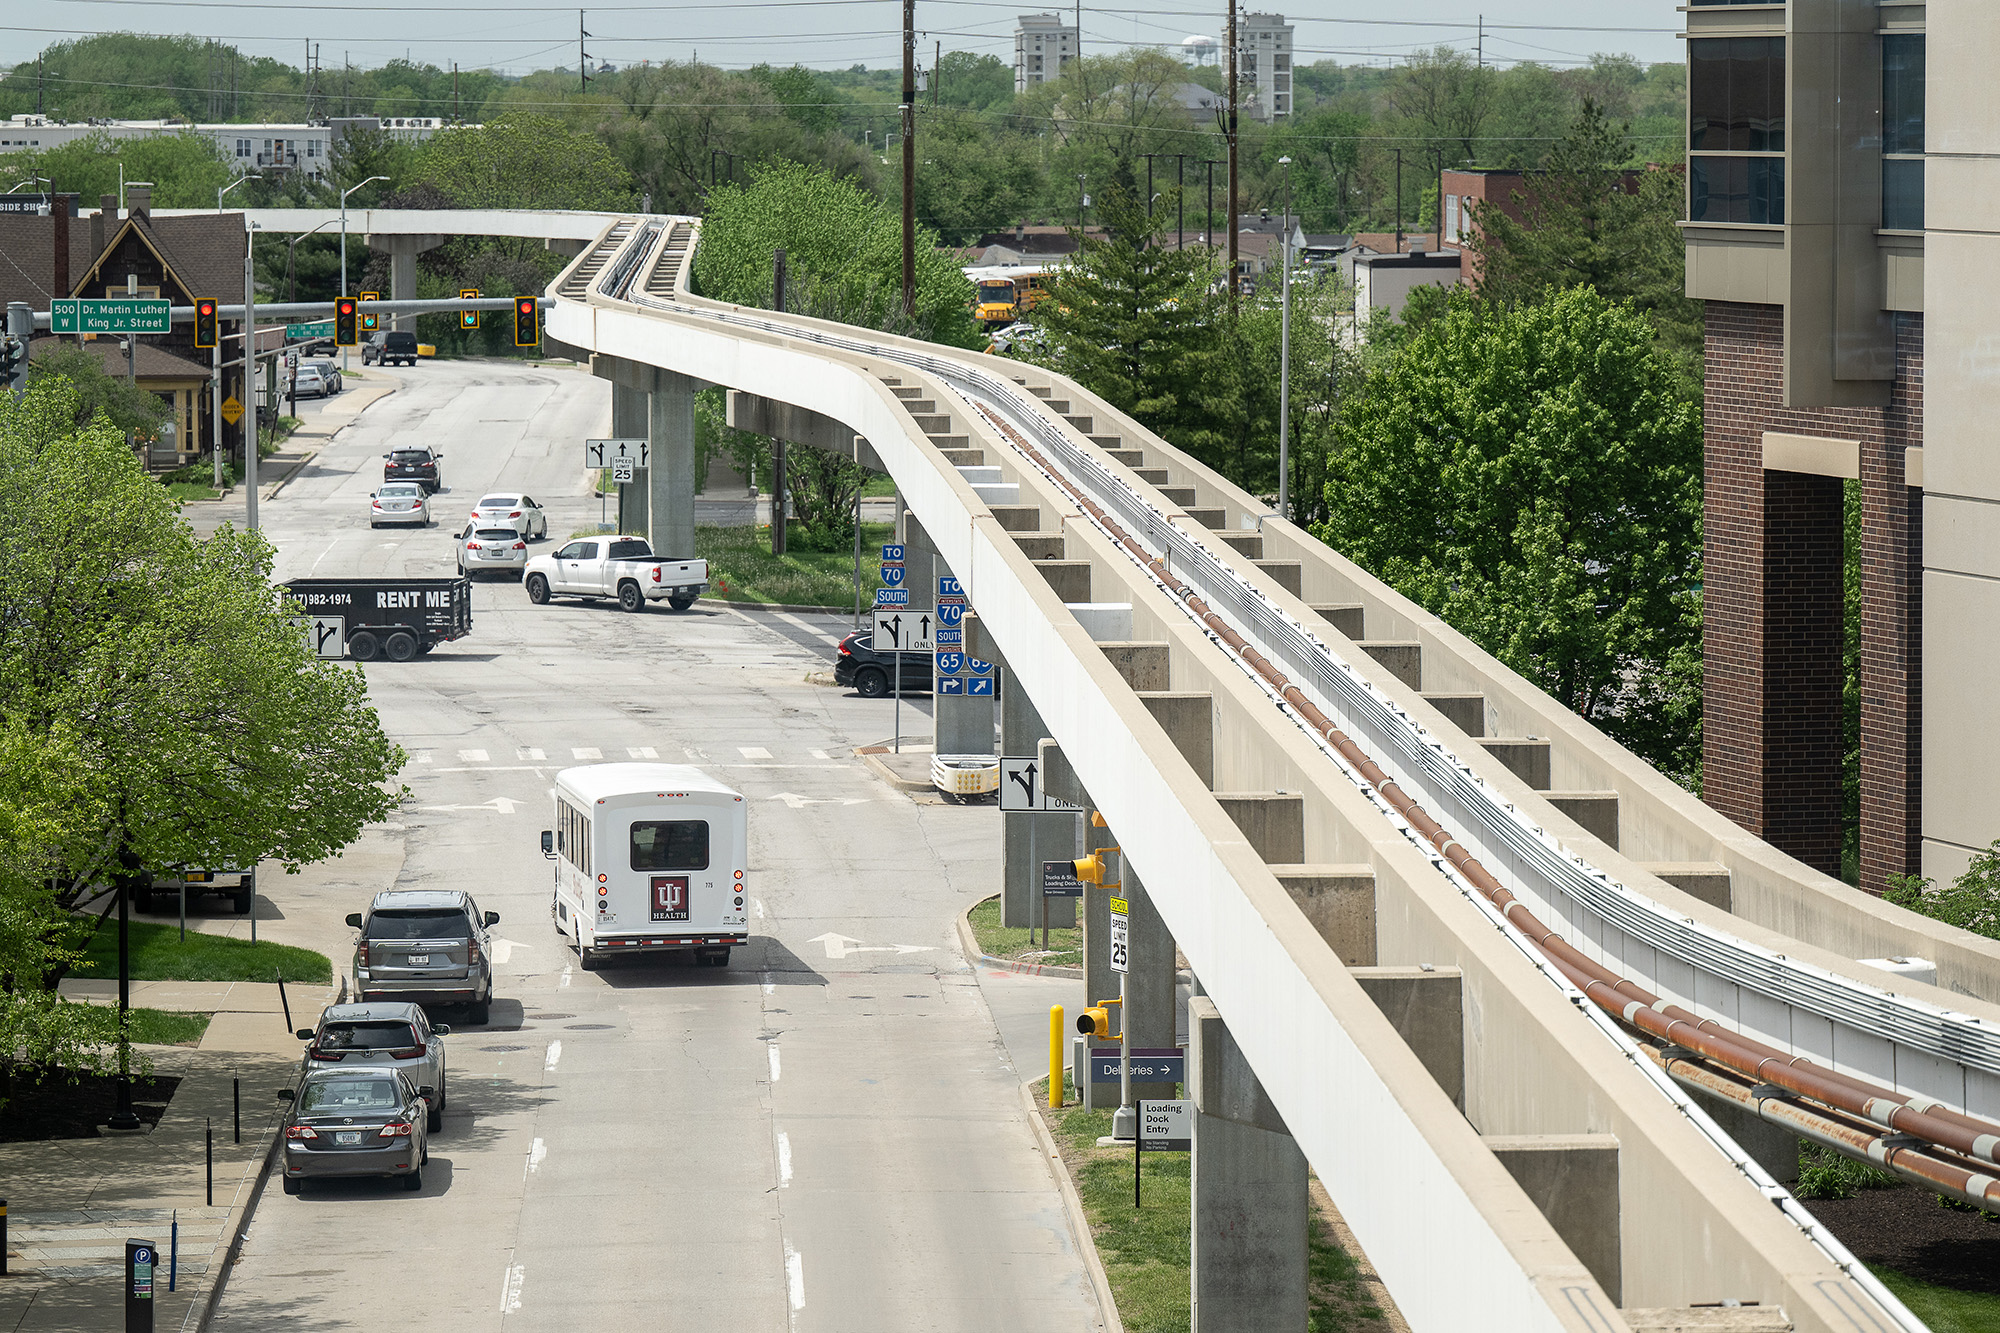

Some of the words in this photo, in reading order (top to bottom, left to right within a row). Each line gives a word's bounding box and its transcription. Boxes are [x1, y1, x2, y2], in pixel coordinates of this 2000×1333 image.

[55, 305, 75, 314] 500
[83, 305, 96, 314] Dr.
[100, 305, 131, 314] Martin
[135, 305, 167, 314] Luther
[61, 319, 69, 327] W
[88, 318, 109, 329] King
[114, 318, 126, 327] Jr.
[131, 318, 163, 327] Street
[615, 470, 631, 479] 25
[885, 548, 901, 557] TO
[885, 569, 900, 581] 70
[943, 581, 961, 591] TO
[377, 592, 421, 608] RENT
[426, 592, 450, 607] ME
[879, 591, 906, 602] SOUTH
[942, 606, 960, 619] 70
[938, 632, 961, 641] SOUTH
[941, 654, 959, 668] 65
[1054, 799, 1081, 808] ONL
[1111, 900, 1127, 912] SCHOOL
[1112, 919, 1127, 930] SPEED
[1114, 931, 1125, 941] LIMIT
[1113, 943, 1127, 965] 25
[1103, 1065, 1153, 1075] Deleries
[1146, 1104, 1182, 1114] Loading
[1146, 1115, 1169, 1123] Dock
[1146, 1126, 1169, 1134] Entry
[140, 1251, 147, 1260] P
